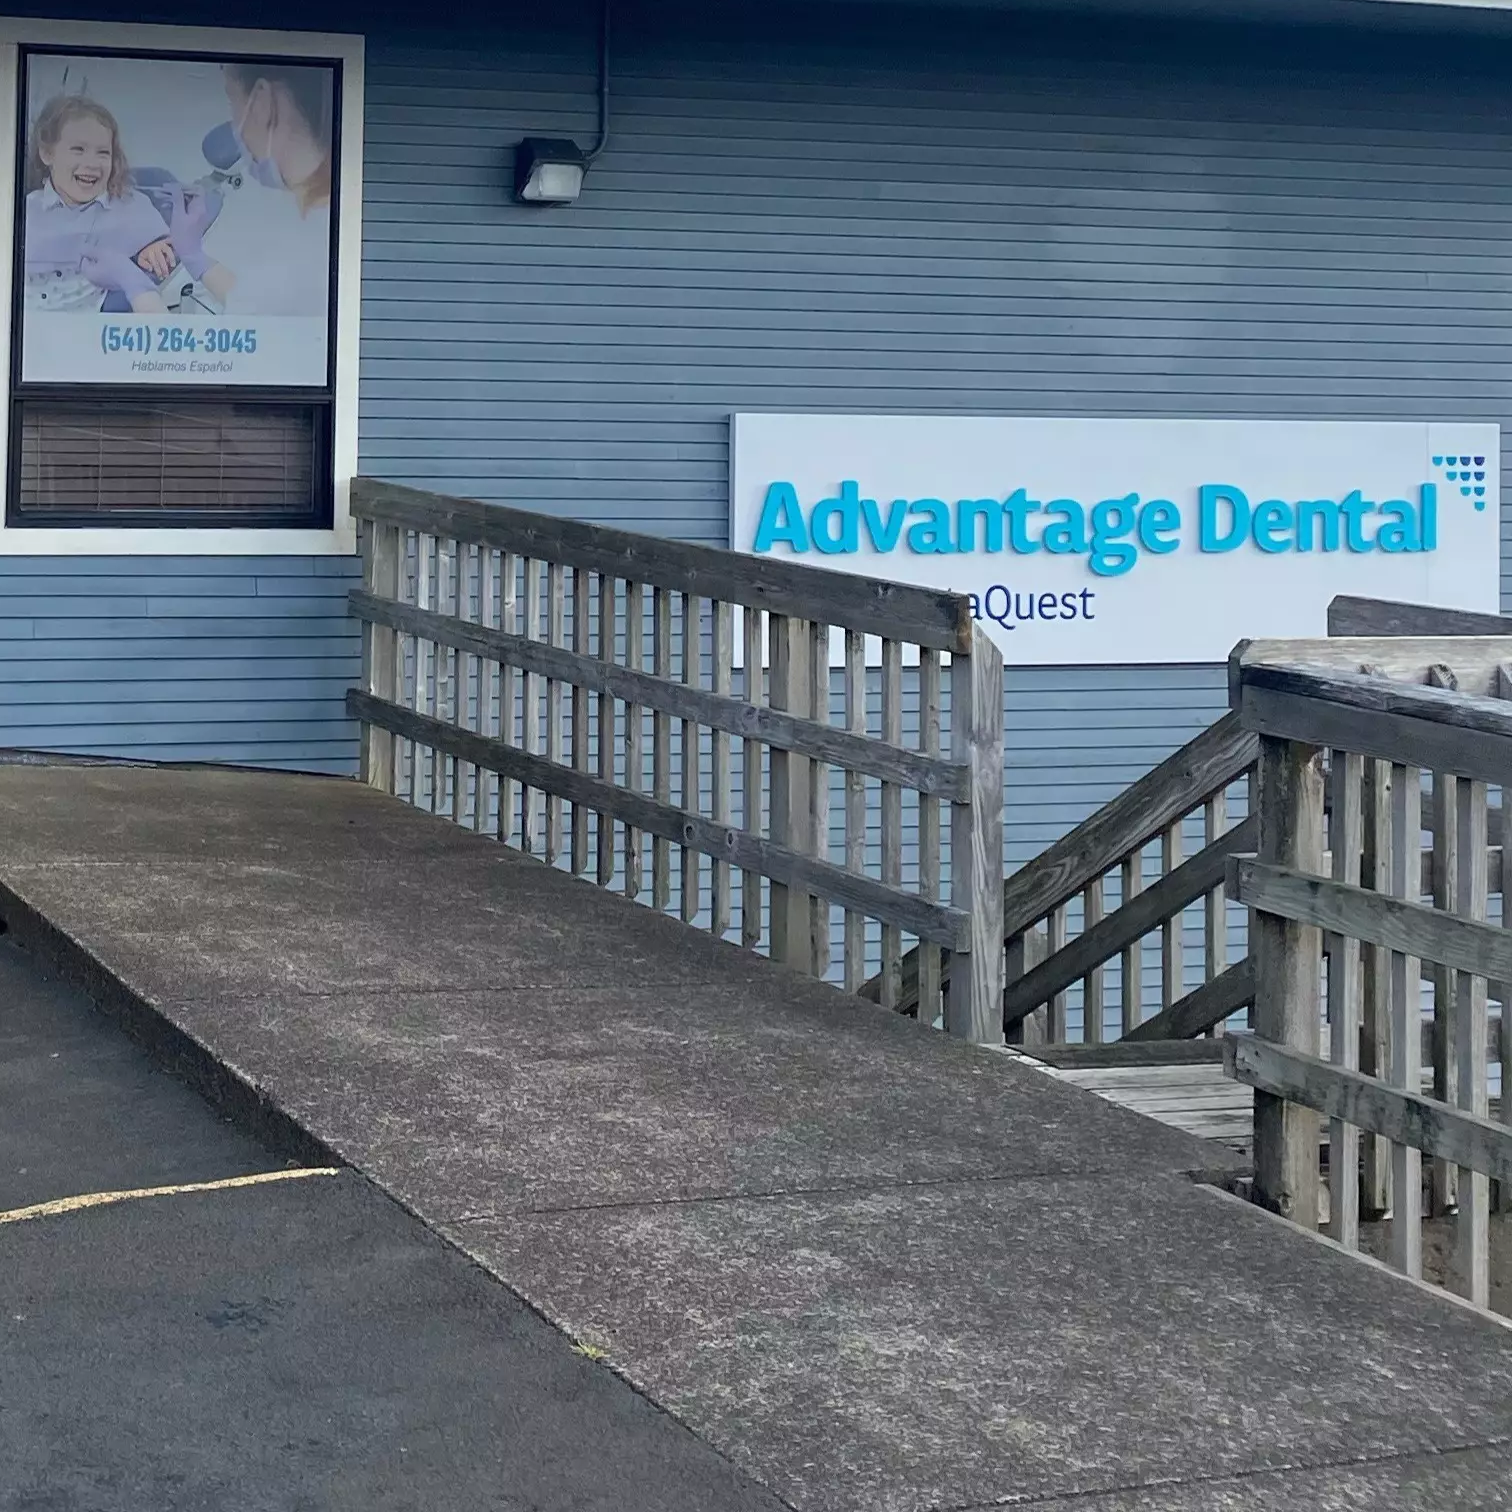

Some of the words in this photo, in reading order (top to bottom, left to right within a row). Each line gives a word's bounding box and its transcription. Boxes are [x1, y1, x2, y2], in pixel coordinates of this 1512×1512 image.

[101, 324, 152, 356] (541)
[157, 326, 257, 355] 264-3045
[132, 359, 187, 372] Hablamos
[189, 360, 234, 374] Español
[753, 480, 1181, 577] Advantage
[1197, 481, 1439, 554] Dental
